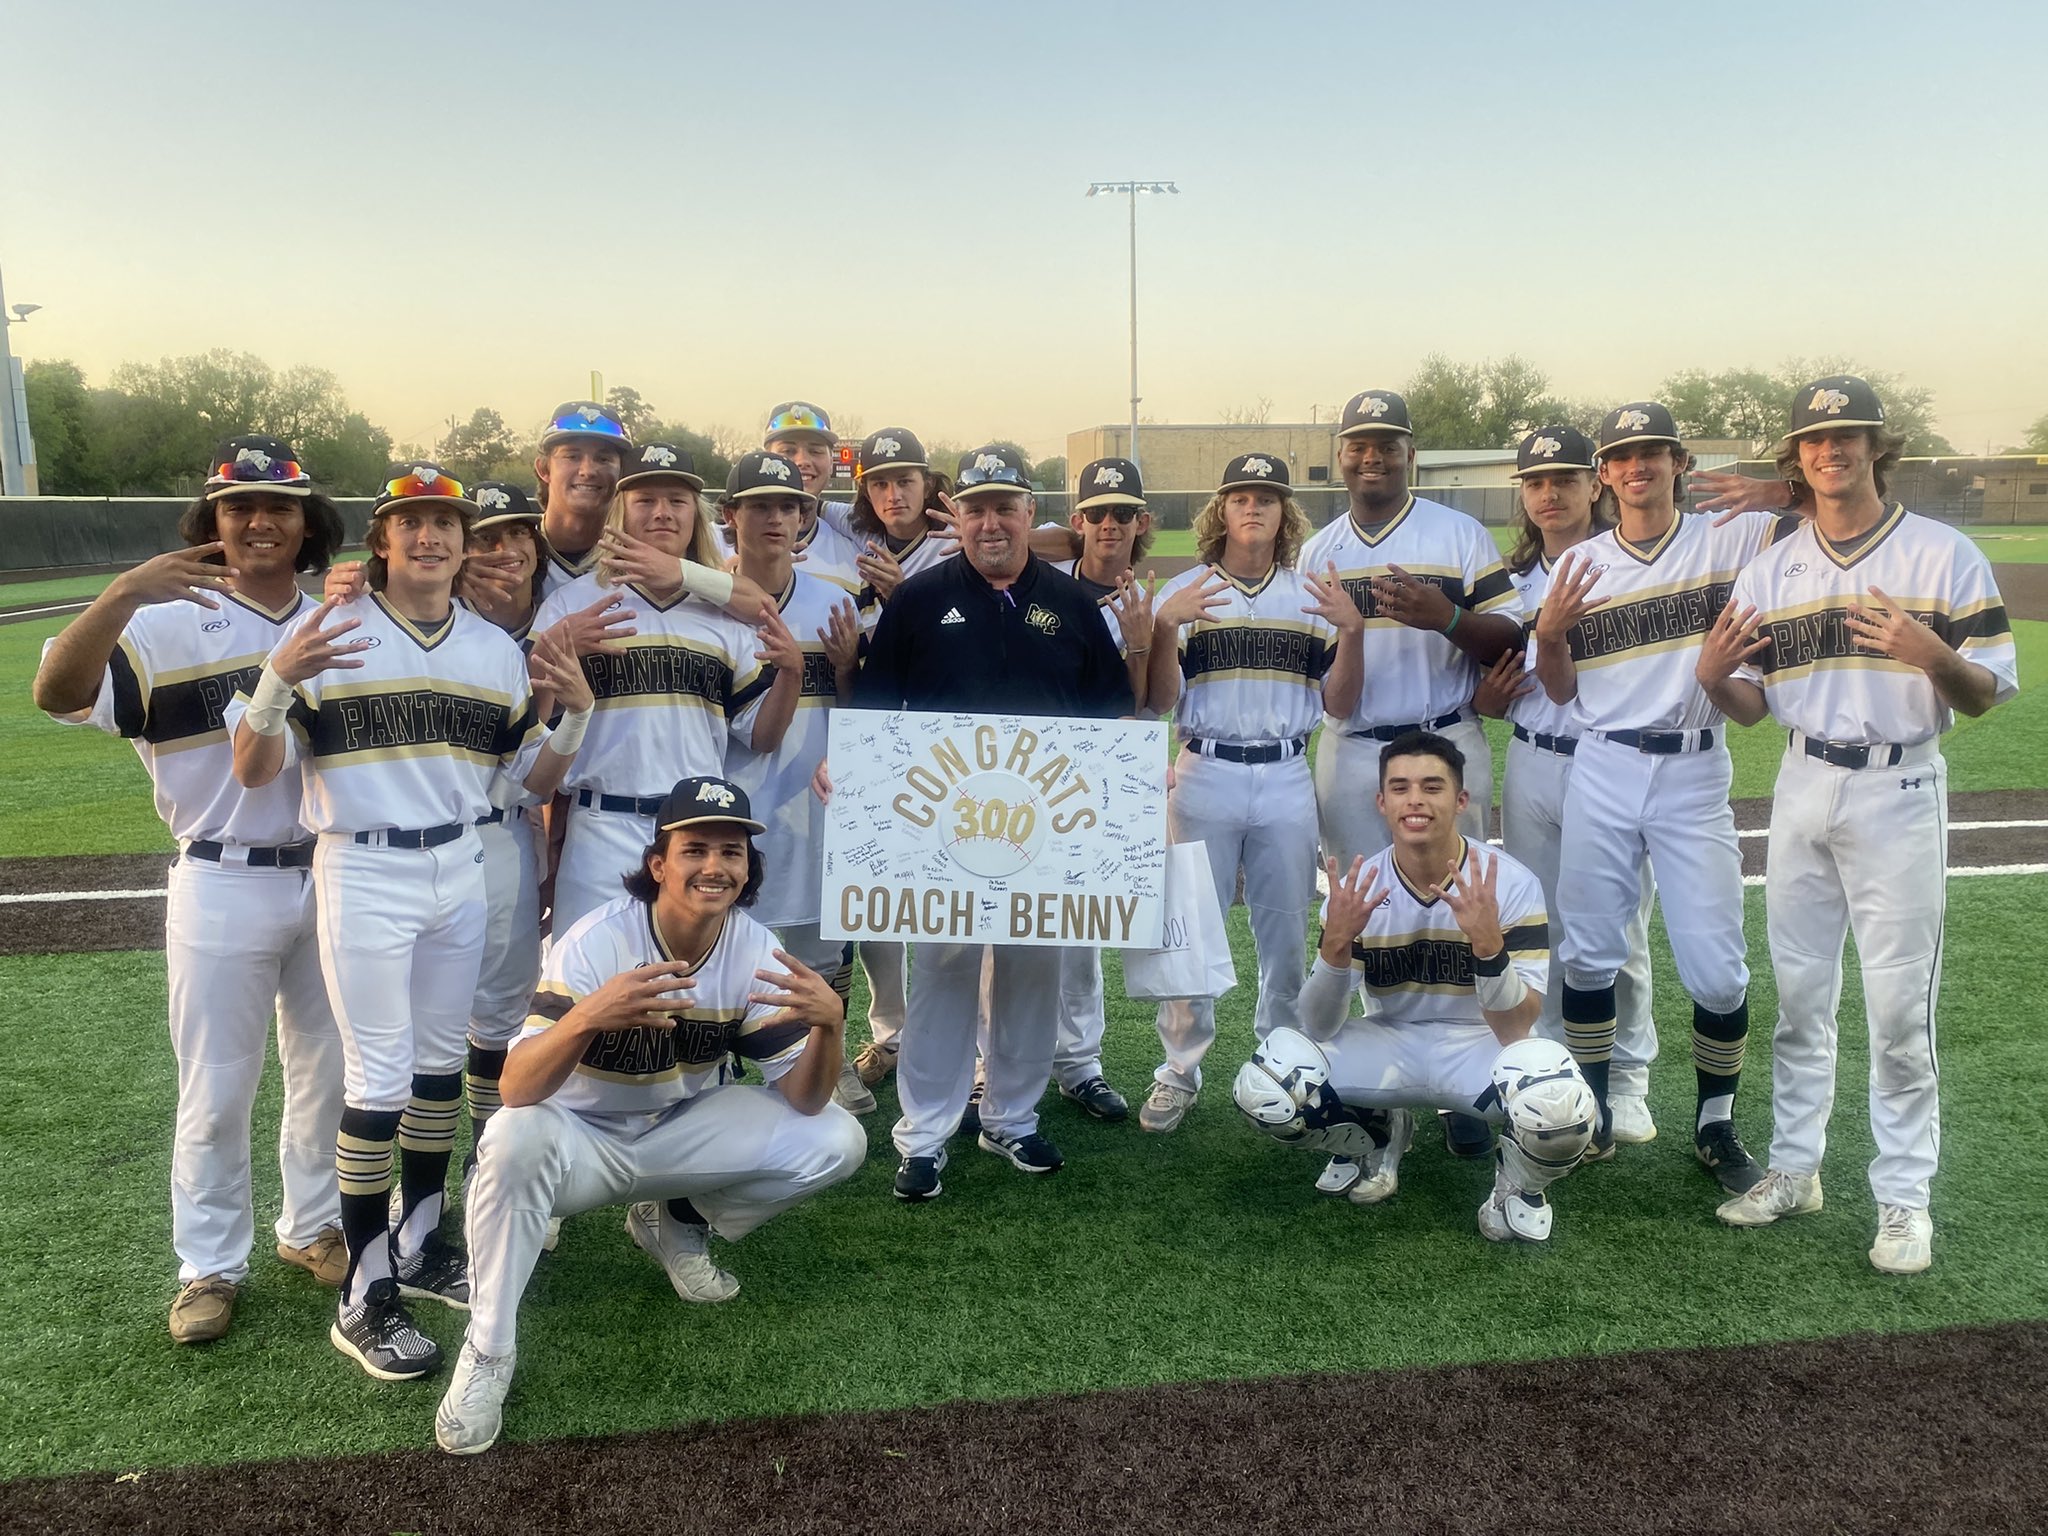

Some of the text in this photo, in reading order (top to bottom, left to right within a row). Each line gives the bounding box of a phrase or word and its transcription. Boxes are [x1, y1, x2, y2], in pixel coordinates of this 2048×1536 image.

[892, 725, 1097, 834] CONGRATS
[952, 798, 1036, 844] 300
[840, 885, 1139, 941] COACH BENNY
